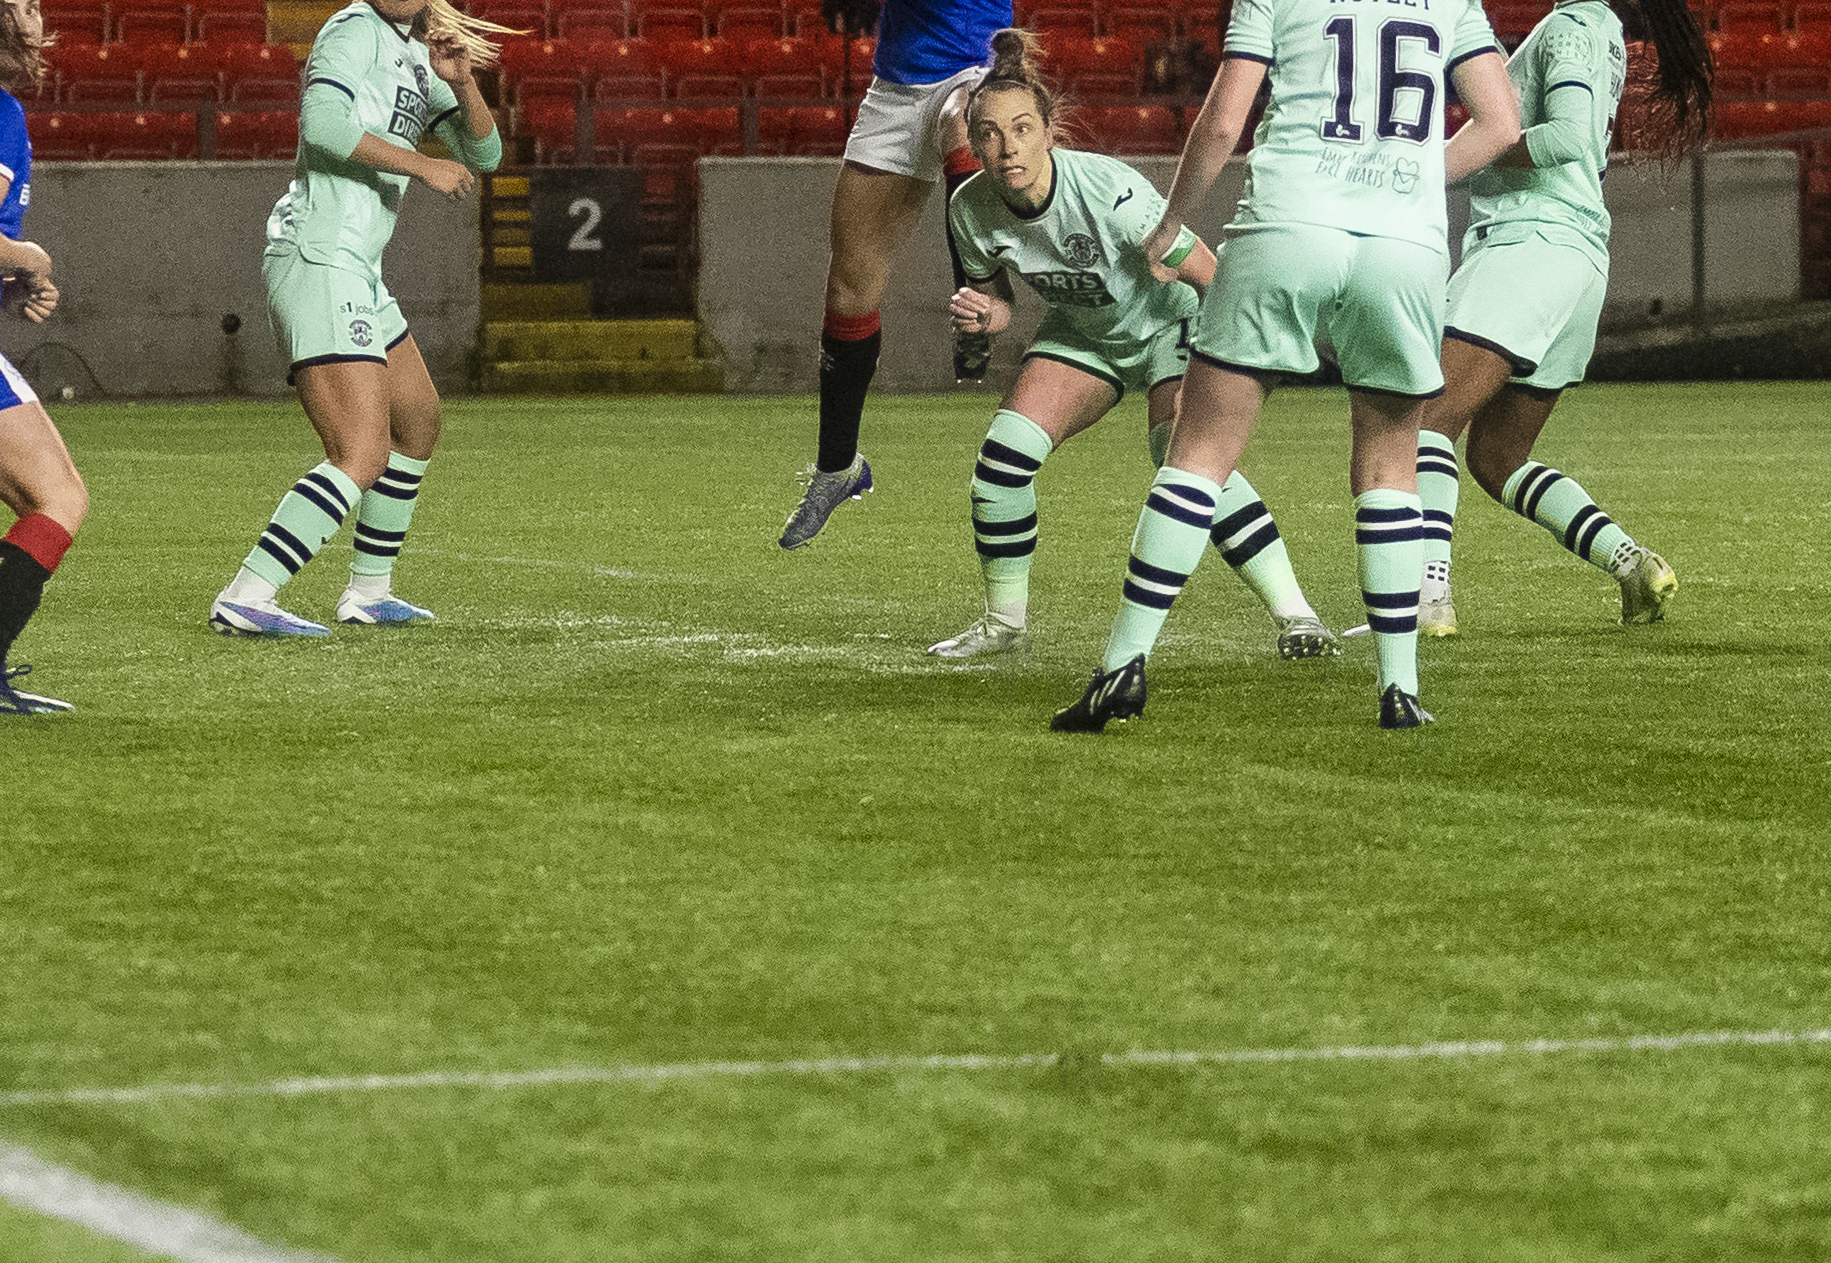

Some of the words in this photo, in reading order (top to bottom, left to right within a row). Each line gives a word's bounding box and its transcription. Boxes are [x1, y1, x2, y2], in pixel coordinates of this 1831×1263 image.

[1321, 15, 1441, 145] 16
[1345, 167, 1386, 189] HEARTS
[568, 197, 603, 251] 2
